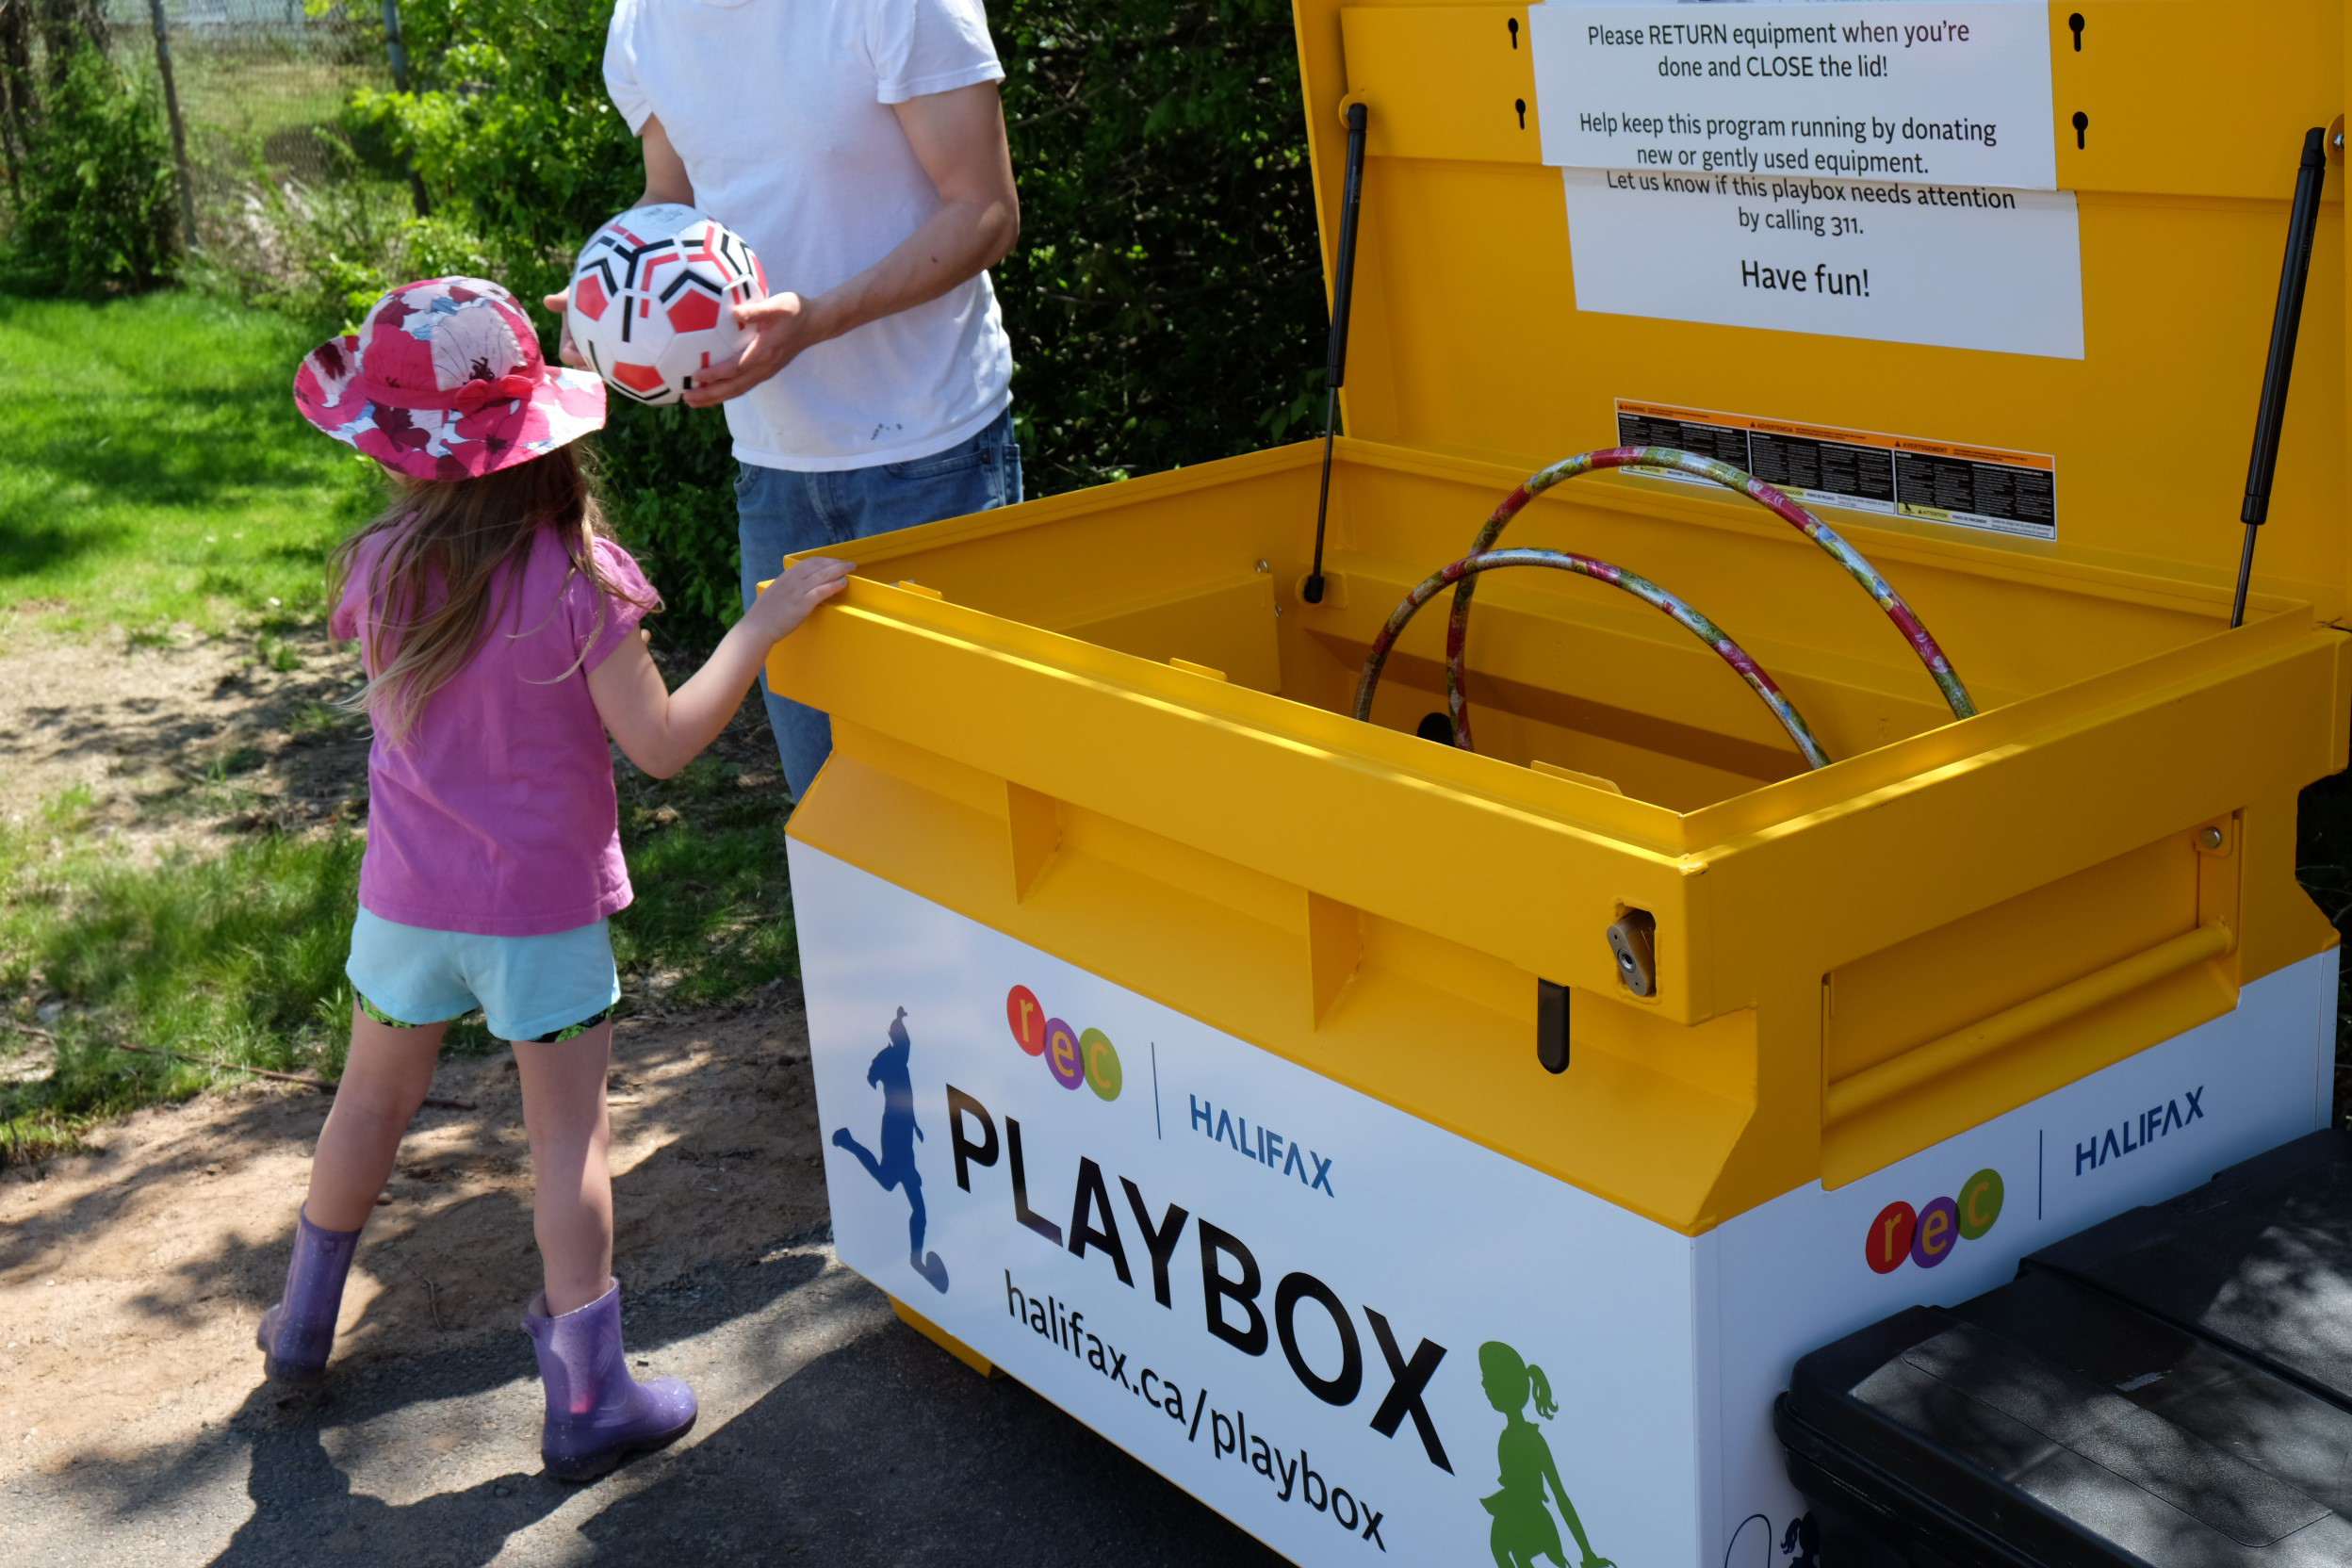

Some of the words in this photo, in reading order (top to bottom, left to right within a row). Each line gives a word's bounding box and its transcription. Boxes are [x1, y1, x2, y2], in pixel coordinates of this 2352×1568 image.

[1588, 24, 1644, 46] Please
[1648, 24, 1728, 45] RETURN
[1732, 22, 1838, 50] equipment
[1841, 20, 1899, 43] when
[1658, 56, 1703, 77] done
[1707, 56, 1741, 77] and
[1746, 57, 1814, 77] CLOSE
[1818, 55, 1853, 77] the
[1857, 55, 1888, 78] lid!
[1579, 112, 1618, 138] Help
[1622, 112, 1664, 139] keep
[1667, 113, 1702, 135] this
[1707, 119, 1785, 140] program
[1790, 116, 1868, 143] running
[1871, 117, 1896, 145] by
[1902, 117, 1998, 148] donating
[1637, 149, 1674, 165] new
[1677, 151, 1697, 166] or
[1702, 146, 1758, 173] gently
[1763, 148, 1809, 171] used
[1814, 150, 1929, 177] equipment.
[1606, 171, 1636, 189] Let
[1639, 176, 1660, 191] us
[1662, 172, 1710, 194] know
[1715, 175, 1728, 195] if
[1731, 176, 1769, 198] this
[1772, 177, 1847, 204] playbox
[1850, 183, 1912, 204] needs
[1916, 186, 2017, 210] attention
[1738, 206, 1760, 233] by
[1765, 209, 1826, 237] calling
[1830, 217, 1864, 237] 311.
[1740, 260, 1807, 292] Have
[1814, 264, 1870, 298] fun!
[1624, 403, 1646, 414] WARNING
[1757, 422, 1793, 433] ADVERTENCIA
[1922, 510, 1948, 518] ATTENTION
[1018, 995, 1114, 1092] rec
[1189, 1094, 1334, 1198] HALIFAX
[1883, 1180, 1991, 1263] rec
[2076, 1086, 2204, 1176] HALIFAX
[946, 1083, 1455, 1476] PLAYBOX
[1005, 1268, 1386, 1552] halifax.ca/playbox
